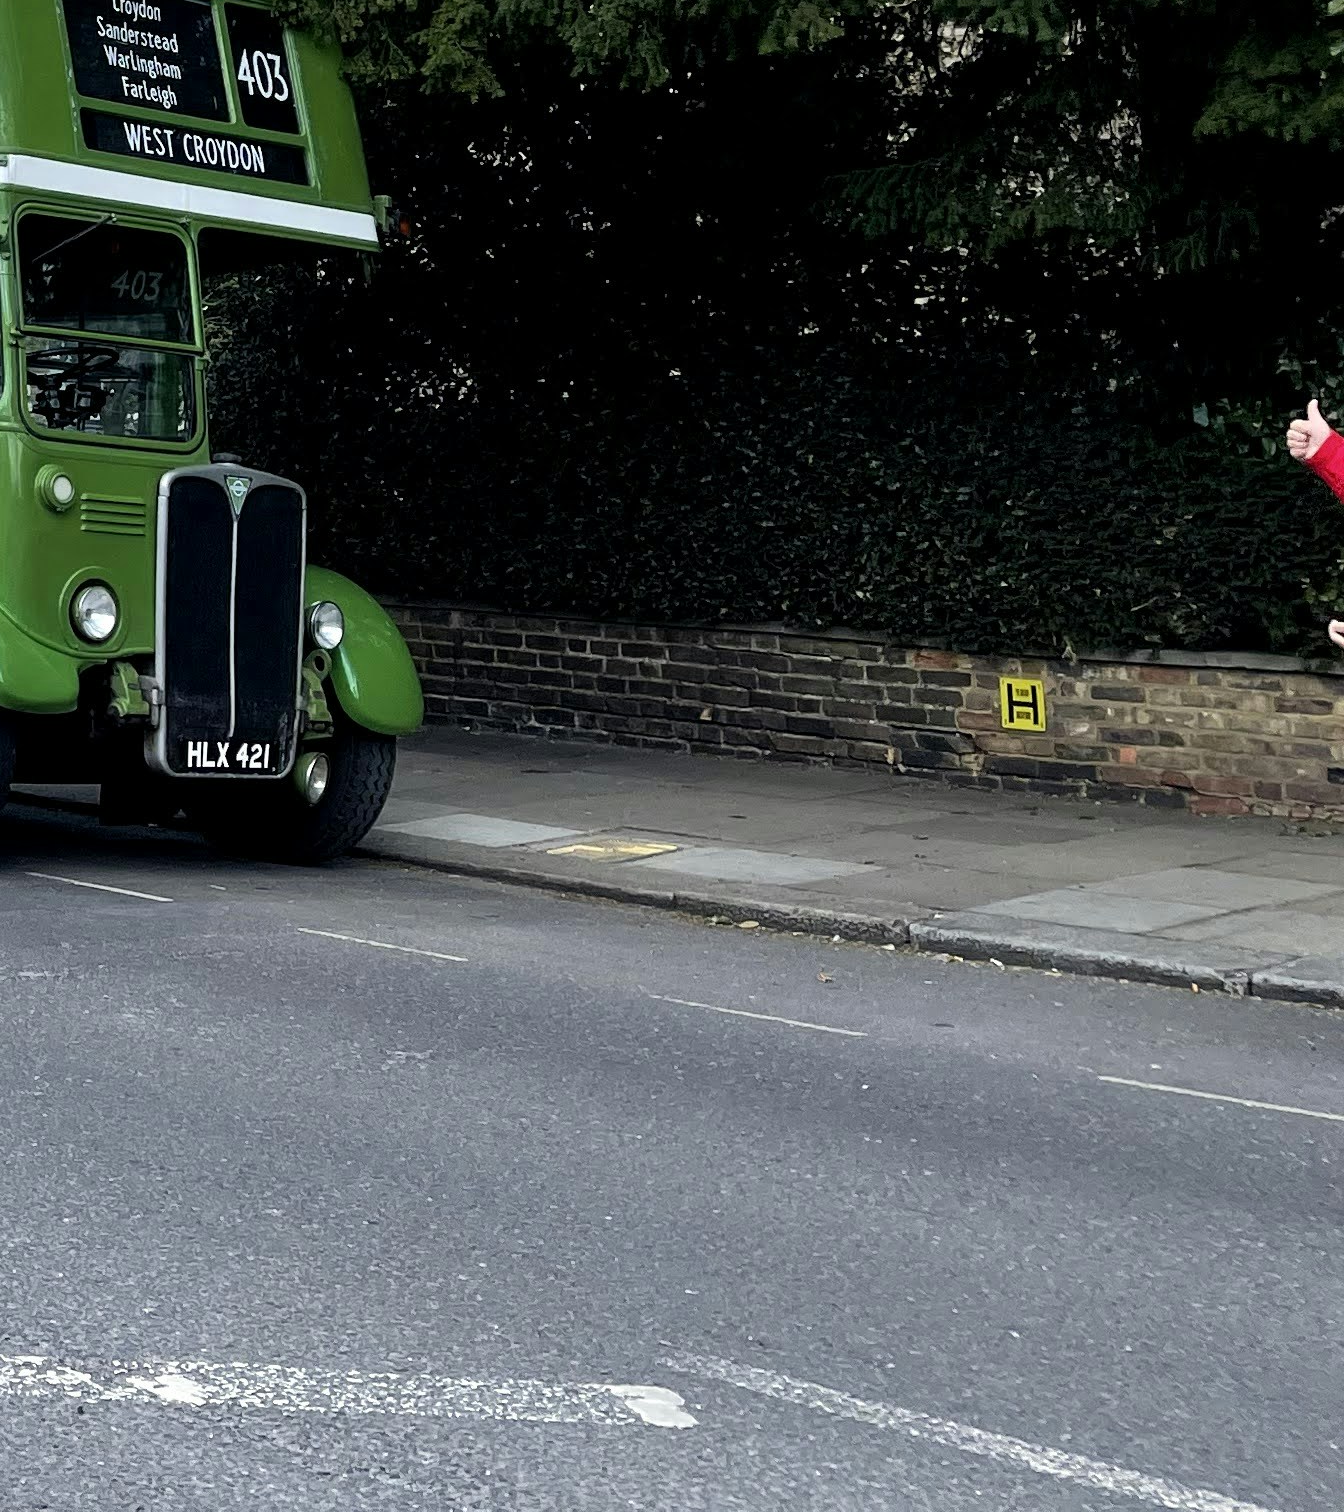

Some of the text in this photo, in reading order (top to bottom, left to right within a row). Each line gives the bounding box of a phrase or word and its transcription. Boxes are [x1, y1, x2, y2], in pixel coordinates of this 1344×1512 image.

[96, 15, 179, 53] Sanderstead
[103, 44, 182, 80] Warlingham
[237, 48, 289, 102] 403
[121, 75, 178, 109] Farleigh
[123, 121, 265, 173] WEST CROYDON
[111, 269, 163, 301] 403
[1006, 683, 1039, 725] H
[187, 740, 271, 769] HLX 421
